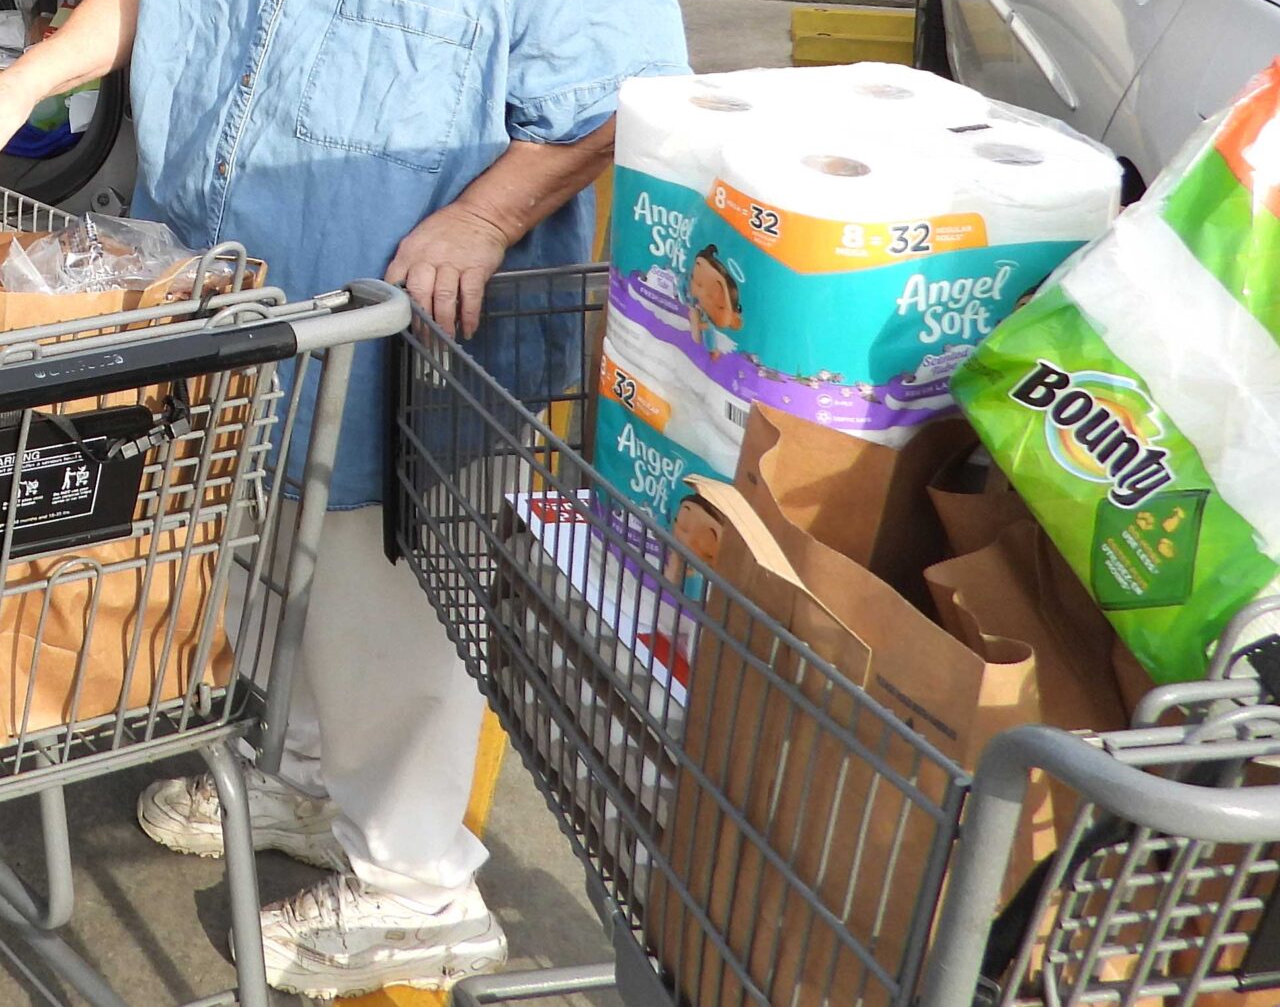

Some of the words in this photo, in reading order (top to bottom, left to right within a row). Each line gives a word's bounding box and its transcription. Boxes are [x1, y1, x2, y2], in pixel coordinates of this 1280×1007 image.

[633, 192, 696, 248] Angel
[714, 186, 727, 210] 8
[749, 201, 781, 237] 32
[648, 225, 687, 273] Soft
[841, 223, 865, 248] 8
[887, 220, 933, 256] 32
[896, 265, 1011, 316] Angel
[920, 300, 992, 344] Soft
[611, 369, 636, 409] 32
[617, 423, 685, 489] Angel
[1010, 360, 1173, 507] Bounty
[631, 459, 669, 513] Soft
